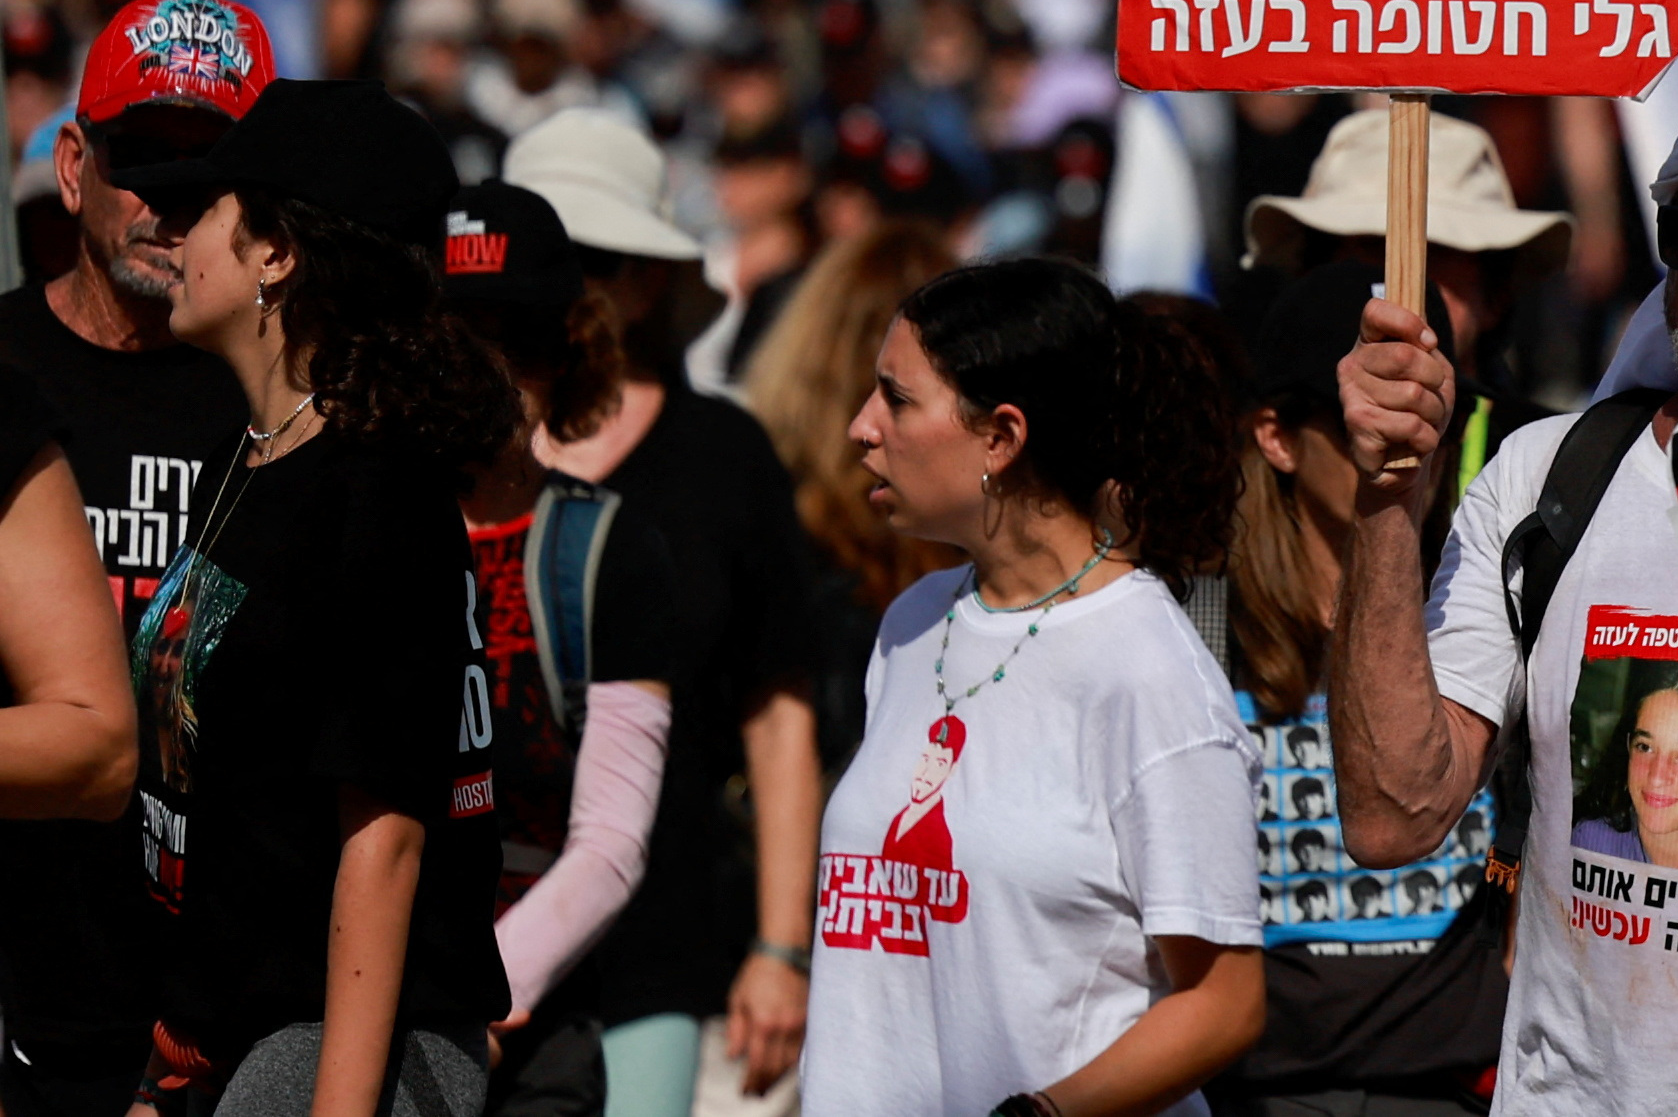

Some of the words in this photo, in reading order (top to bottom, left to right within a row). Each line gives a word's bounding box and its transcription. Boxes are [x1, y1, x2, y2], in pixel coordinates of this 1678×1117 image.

[124, 9, 252, 77] LONDON
[446, 232, 509, 266] NOW
[1592, 623, 1640, 647] לעזה
[923, 867, 960, 908] עד
[1572, 858, 1635, 903] אותם
[1571, 895, 1650, 945] עכשיו!
